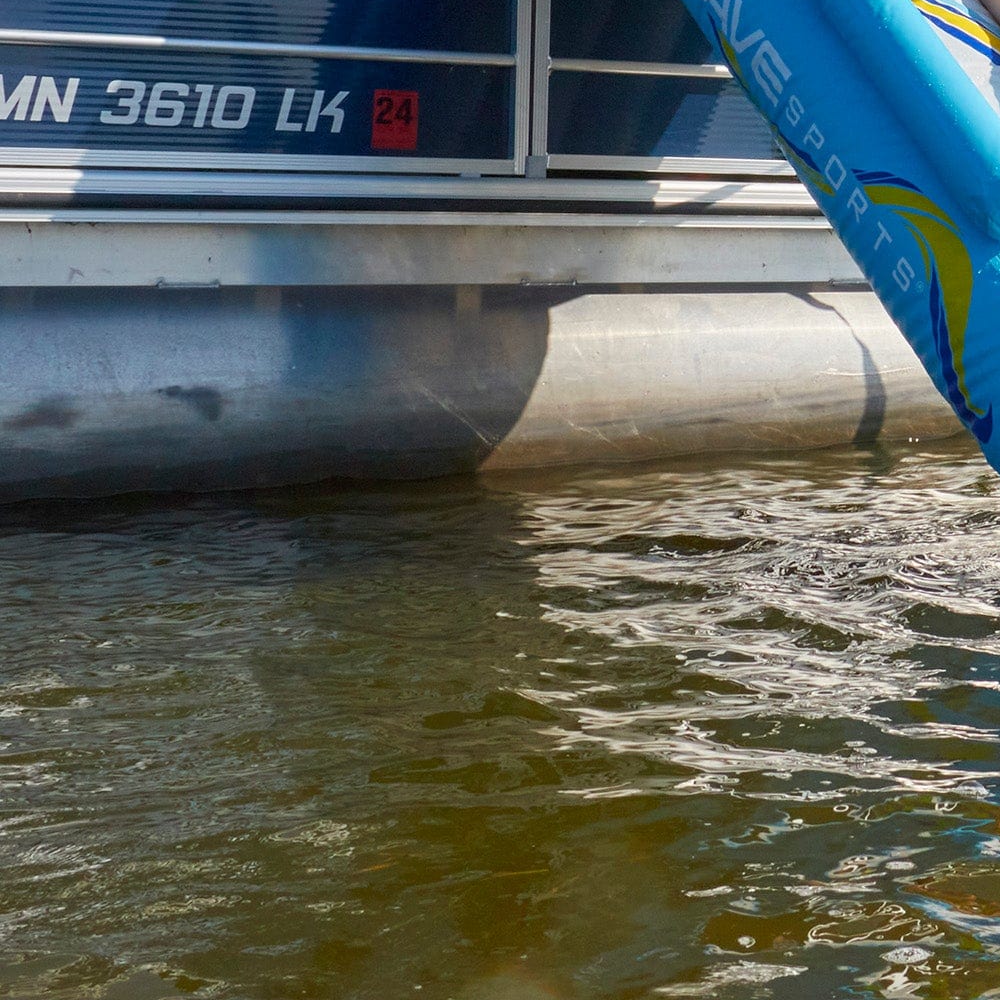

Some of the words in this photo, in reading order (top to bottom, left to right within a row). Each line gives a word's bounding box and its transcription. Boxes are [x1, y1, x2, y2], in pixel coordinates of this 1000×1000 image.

[0, 73, 80, 123] MN
[100, 80, 257, 130] 3610
[275, 87, 351, 134] LK
[375, 96, 413, 126] 24
[786, 94, 916, 293] SPORTS
